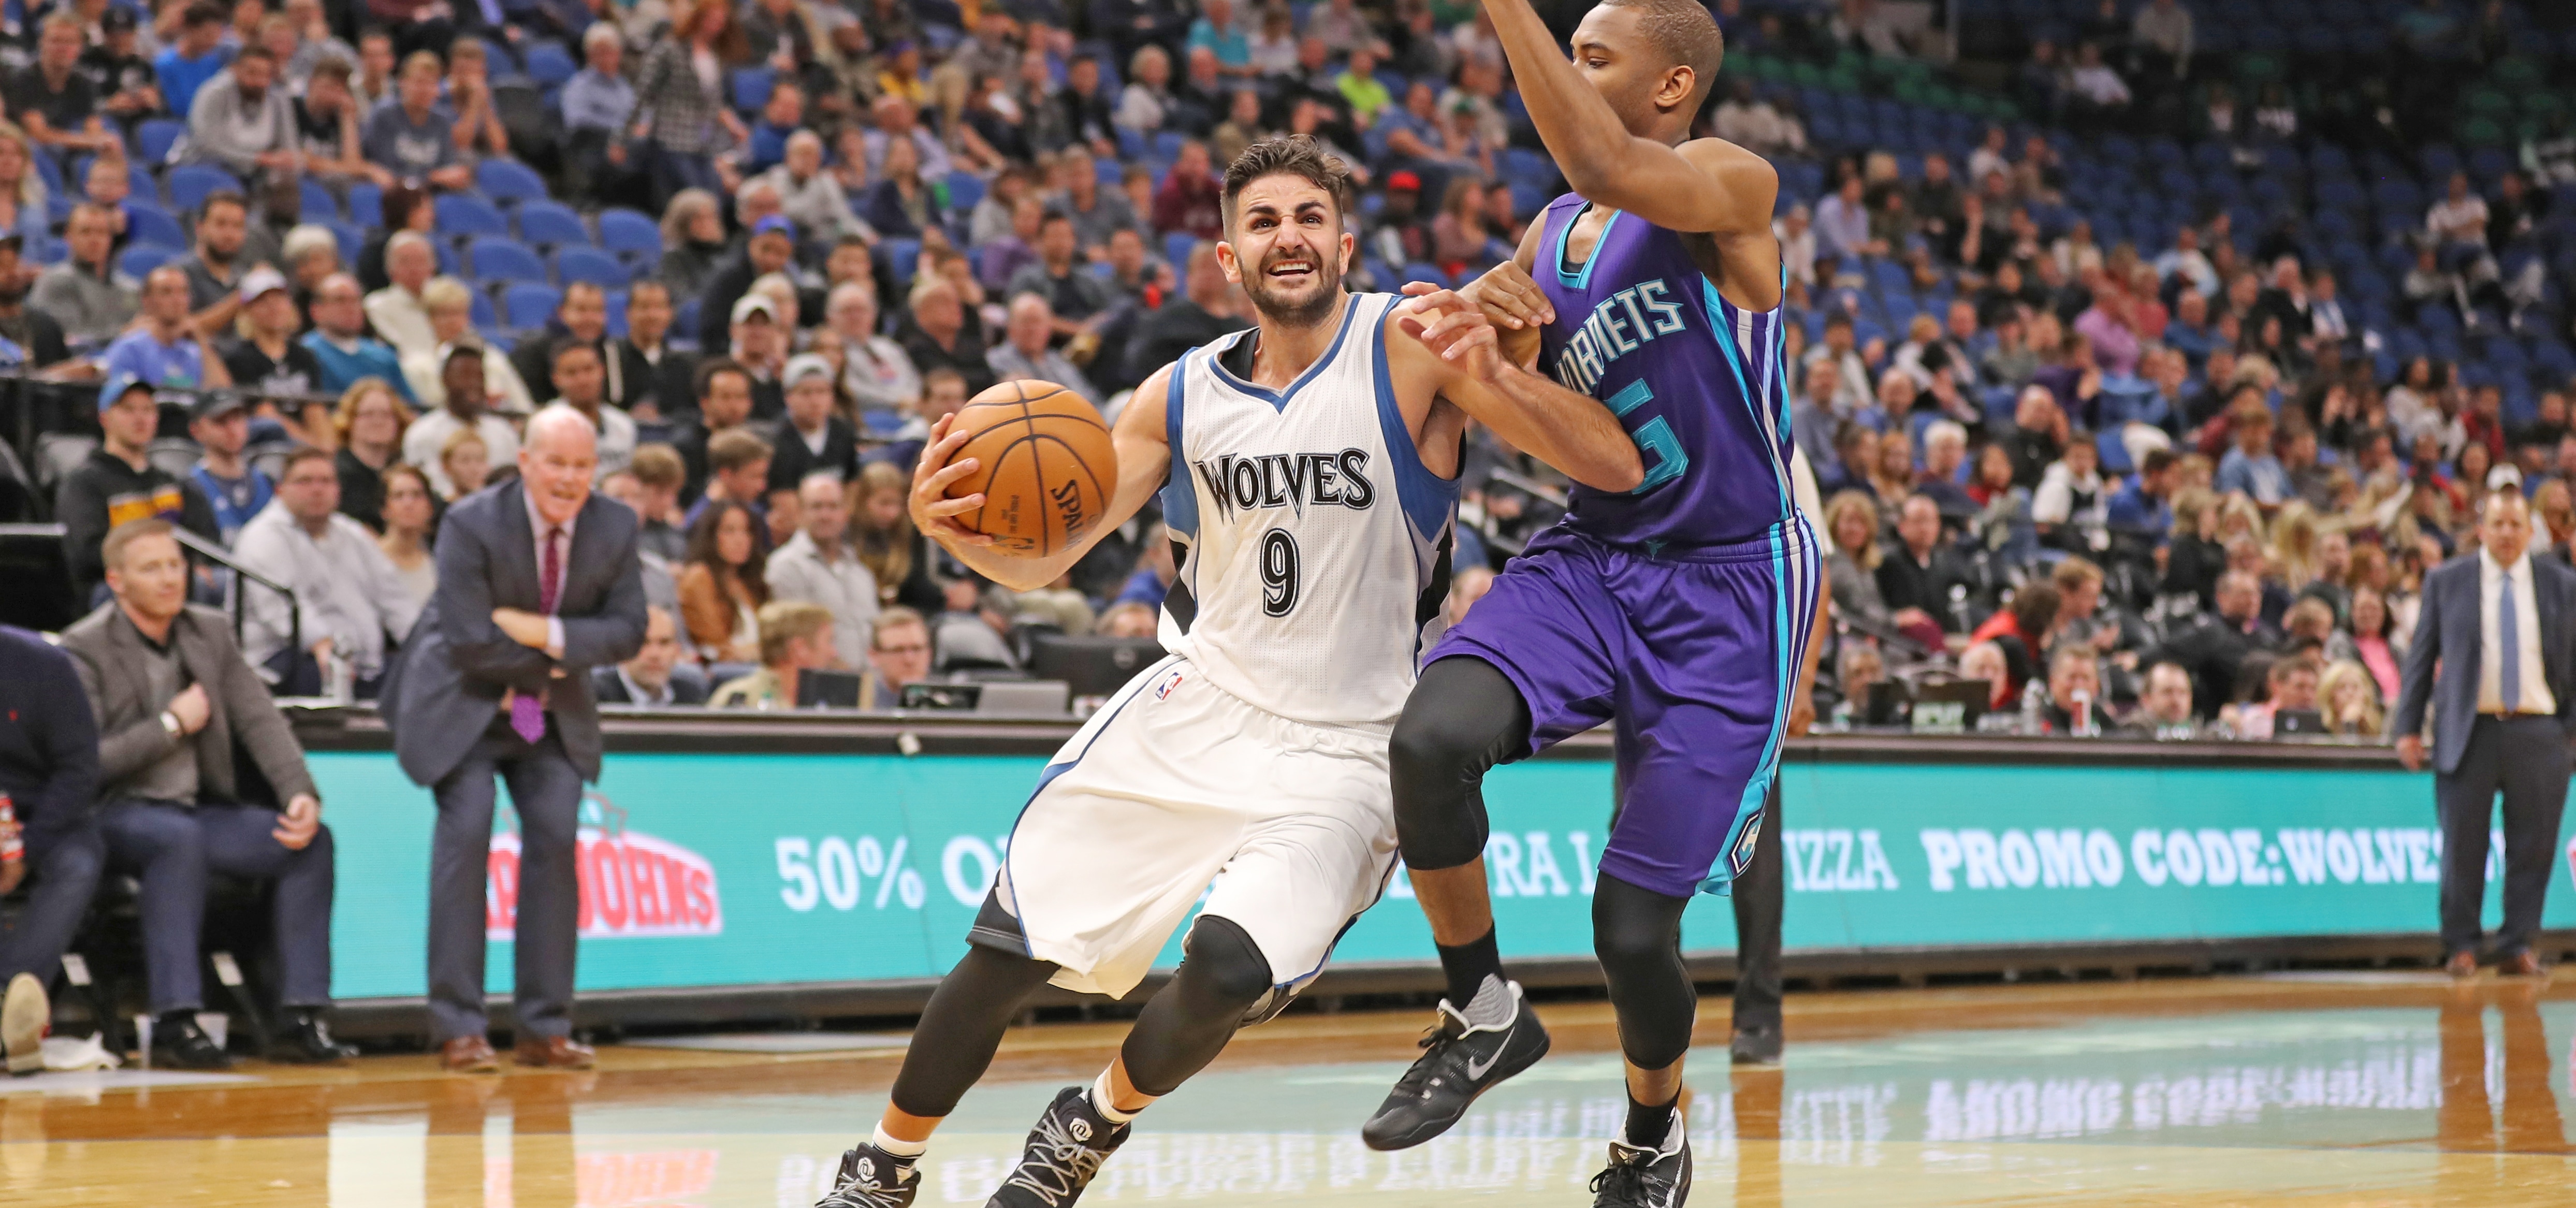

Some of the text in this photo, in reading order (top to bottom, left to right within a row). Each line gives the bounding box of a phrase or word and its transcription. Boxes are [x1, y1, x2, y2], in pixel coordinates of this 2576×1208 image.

[1192, 447, 1376, 525] WOLVES
[1259, 527, 1301, 618] 9
[775, 834, 927, 911] 50%
[940, 834, 1011, 909] O
[1781, 829, 1901, 892] IZZA
[1918, 828, 2123, 892] PROMO
